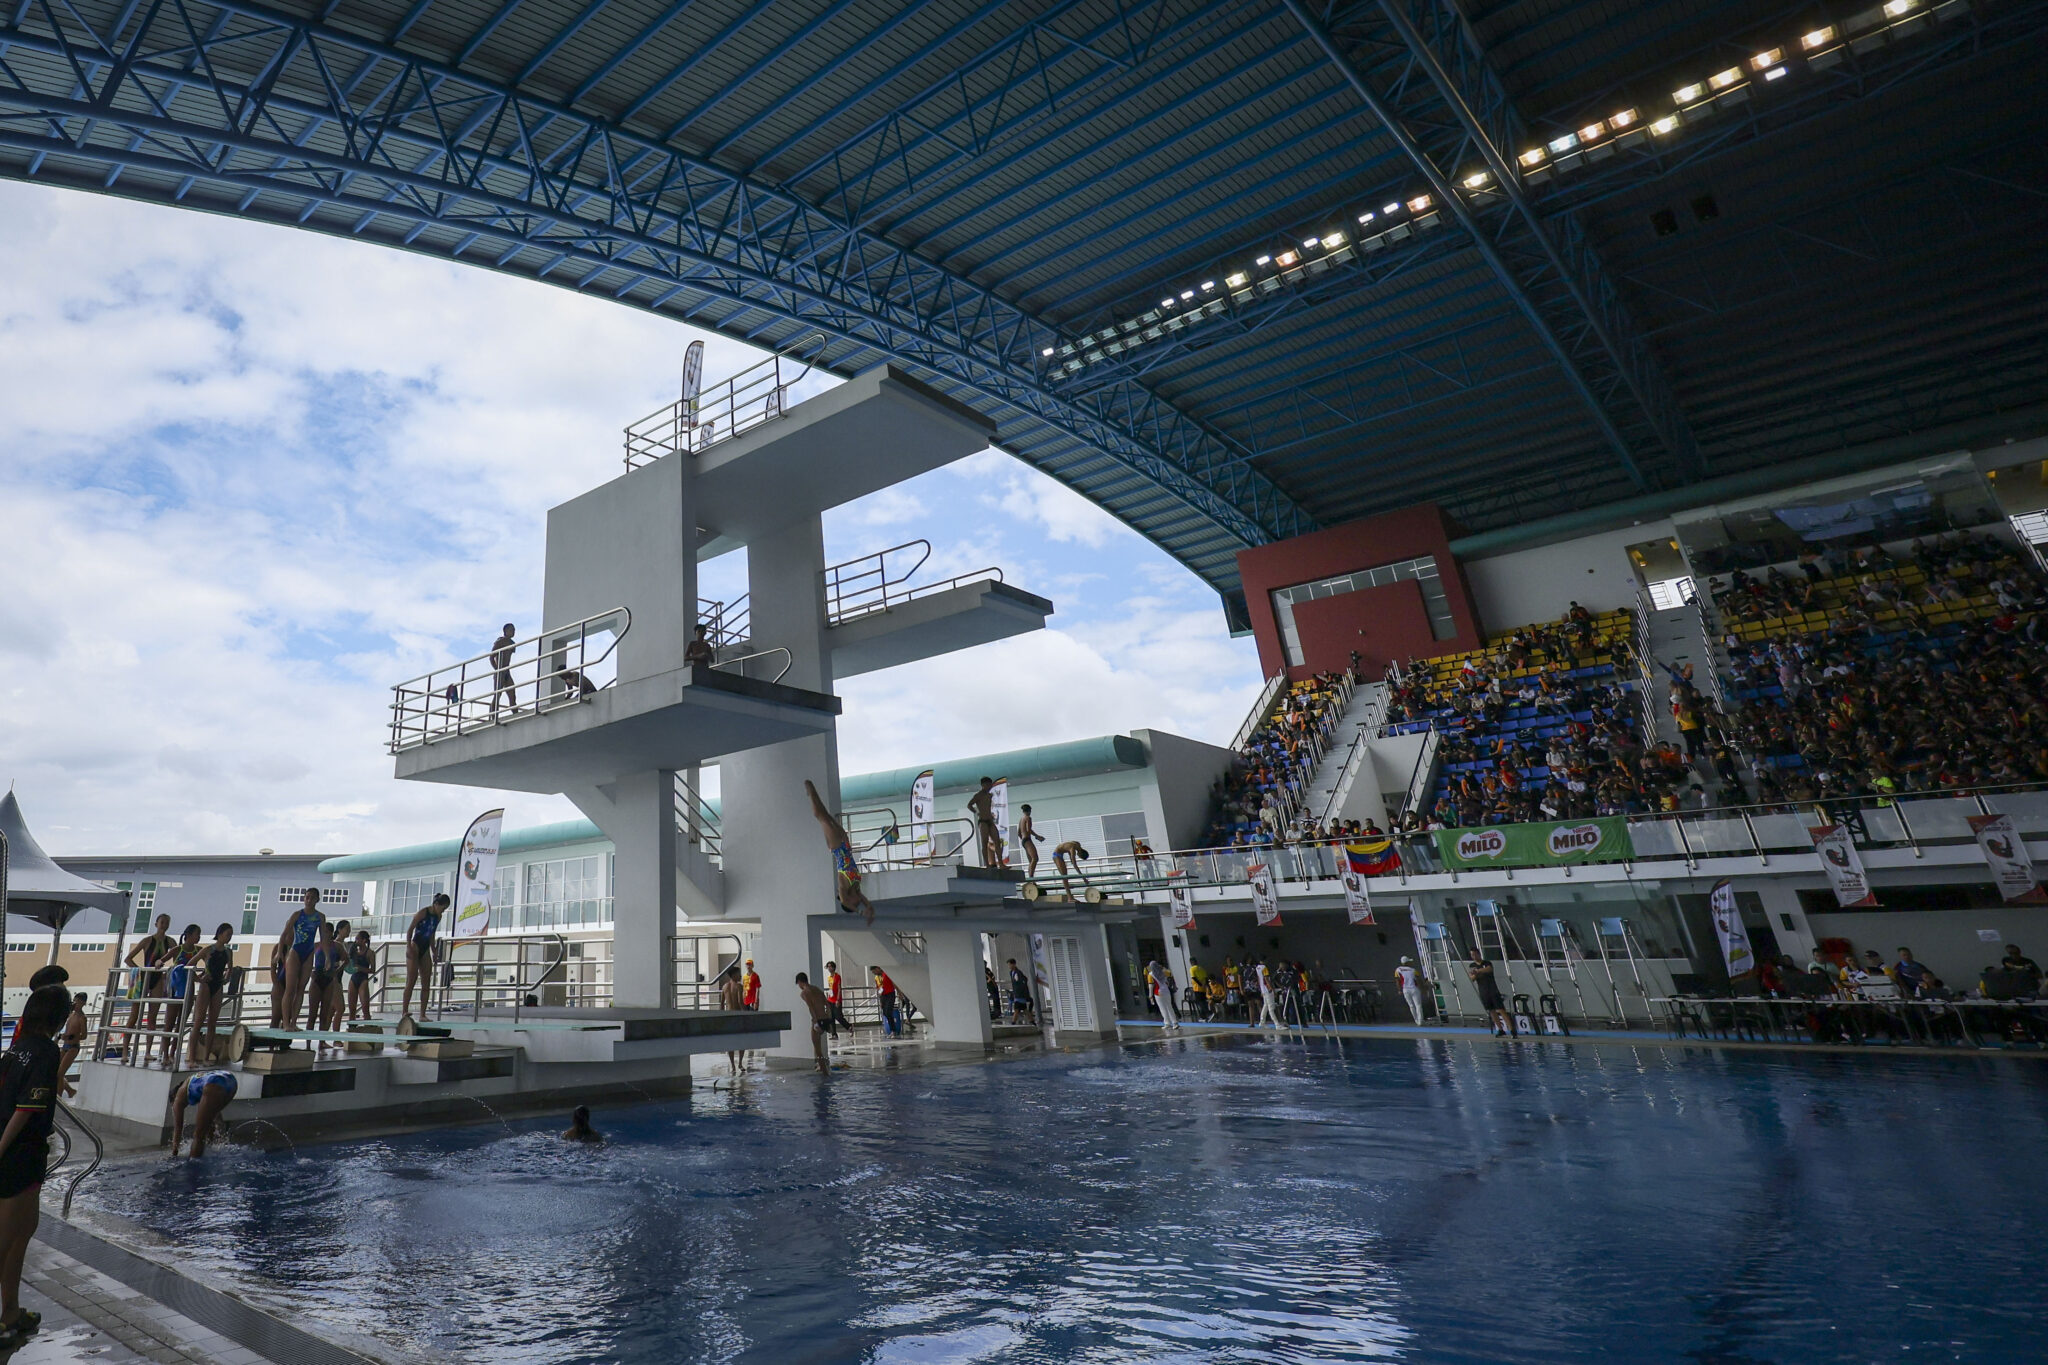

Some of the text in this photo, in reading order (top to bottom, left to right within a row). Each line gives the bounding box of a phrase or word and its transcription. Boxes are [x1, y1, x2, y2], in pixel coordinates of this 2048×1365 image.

[1461, 838, 1502, 854] MILO
[1553, 832, 1598, 849] MILO
[1520, 1018, 1528, 1029] 6
[1548, 1019, 1554, 1029] 7
